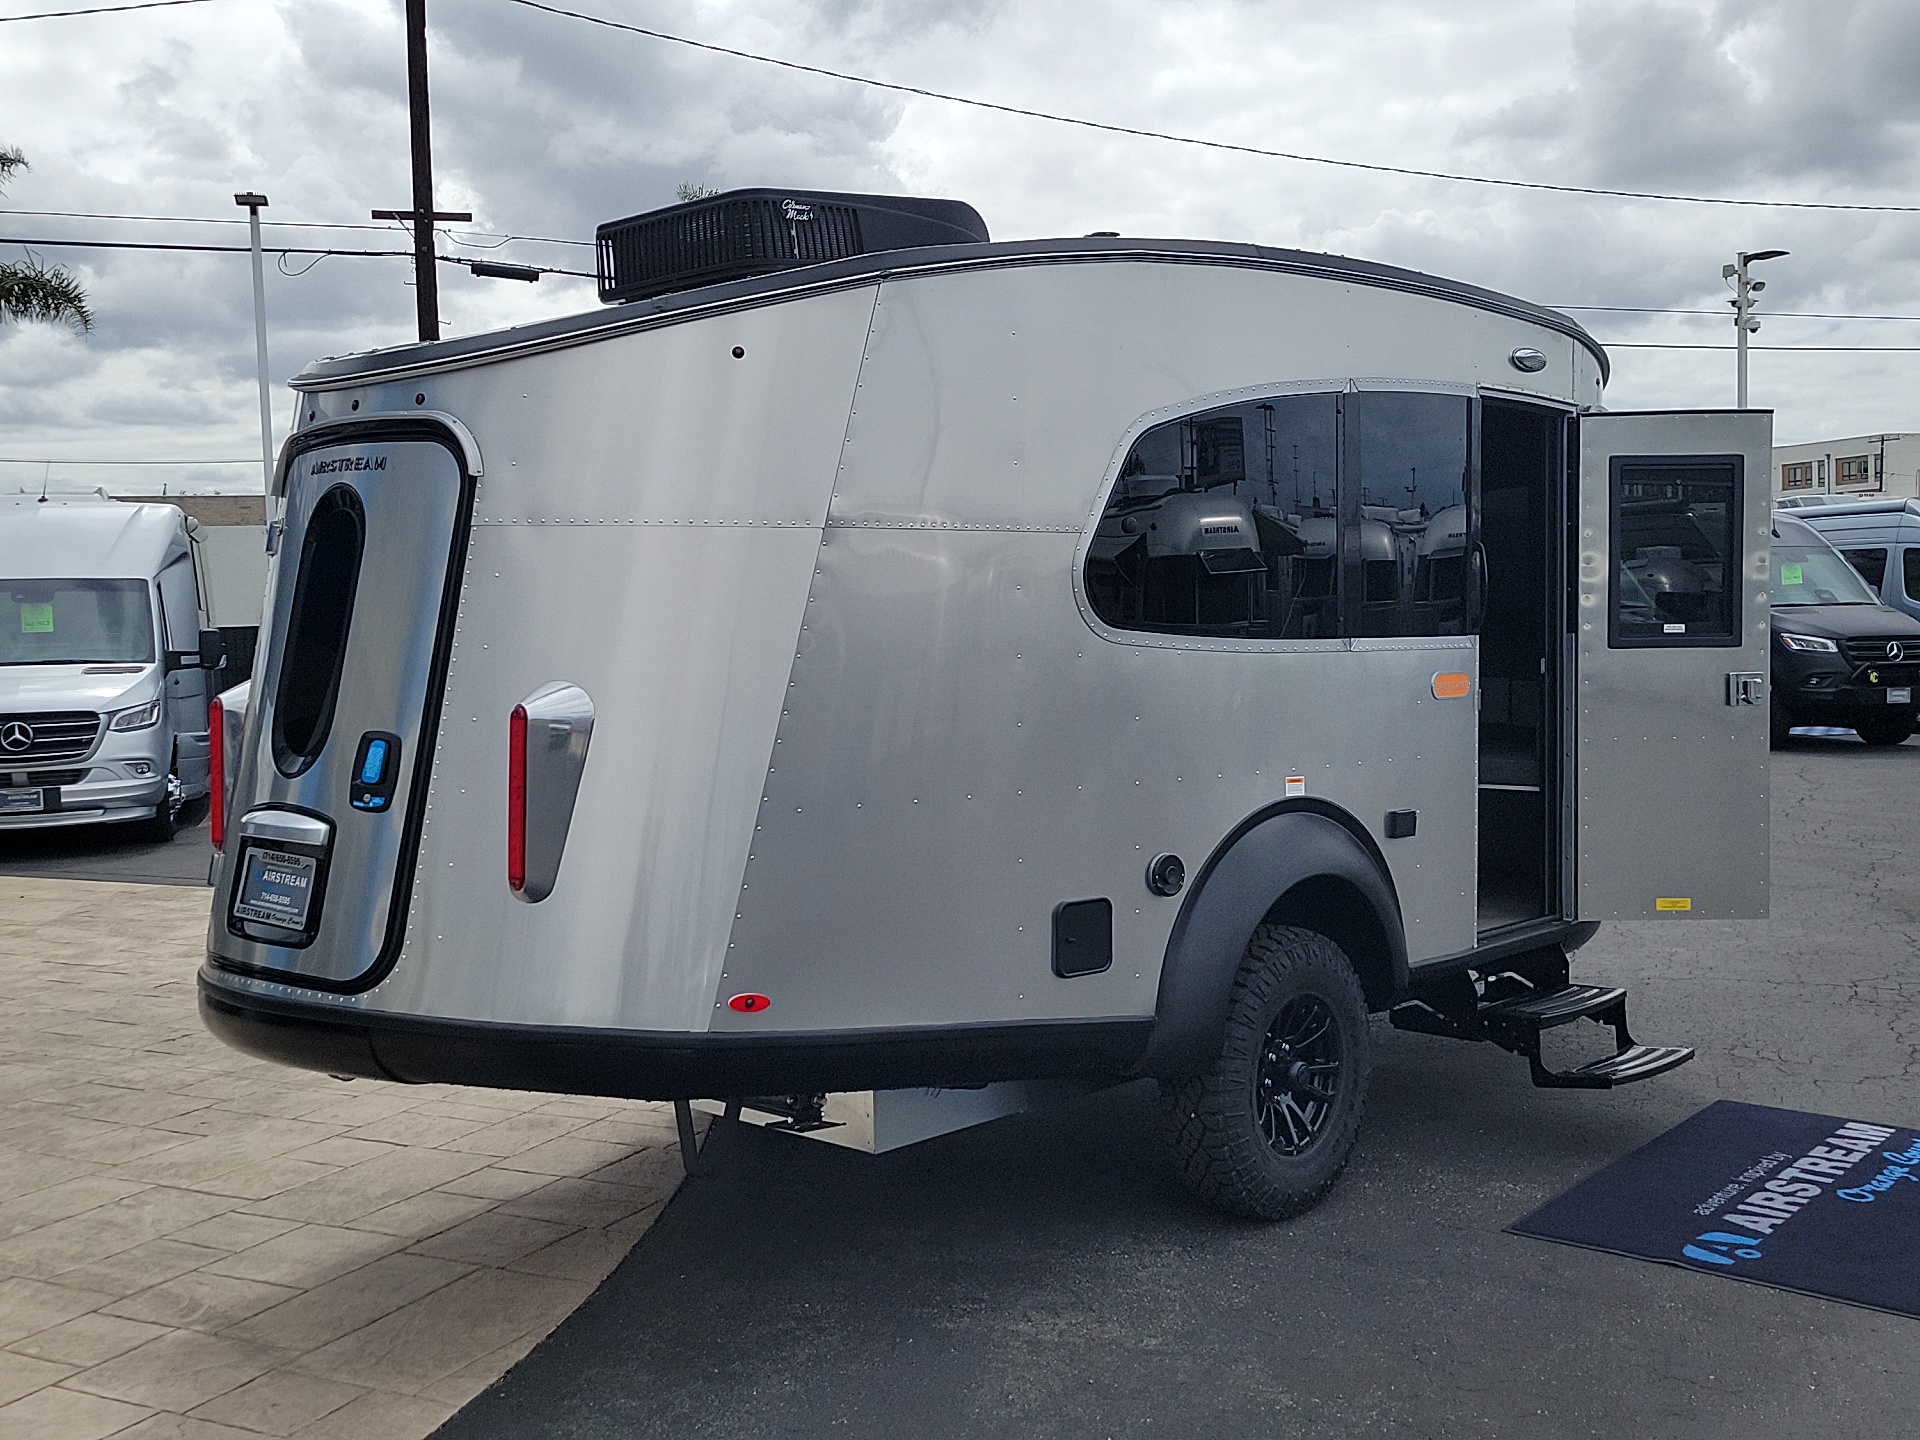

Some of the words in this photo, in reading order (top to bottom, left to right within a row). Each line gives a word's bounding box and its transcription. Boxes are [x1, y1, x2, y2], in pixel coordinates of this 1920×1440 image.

[310, 456, 388, 476] AIRSTREAM
[262, 870, 308, 888] AIRSTREAM
[236, 906, 272, 920] AIRSTREAM
[1721, 1121, 1897, 1235] AIRSTREAM
[1836, 1165, 1919, 1202] Orange
